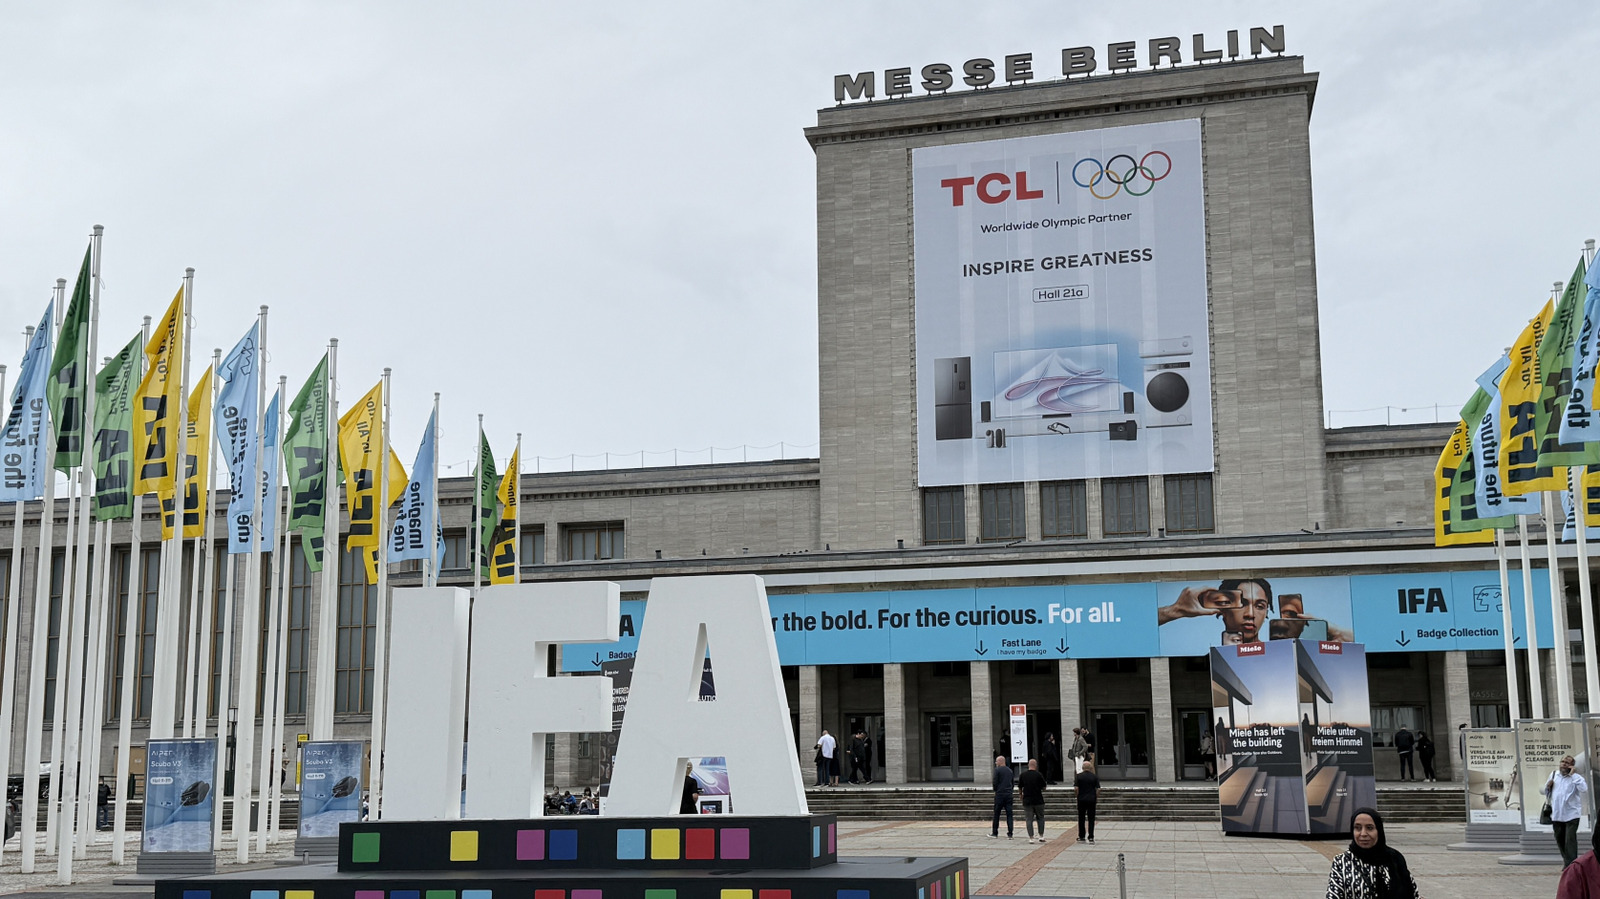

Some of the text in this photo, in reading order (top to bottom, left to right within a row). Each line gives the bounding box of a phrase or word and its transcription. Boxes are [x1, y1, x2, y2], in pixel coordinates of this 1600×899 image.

[834, 25, 1286, 102] MESSE BERLIN
[941, 171, 1044, 207] TCL
[981, 212, 1132, 234] Worldwide Olympic Partner
[963, 248, 1153, 277] INSPIRE GREATNESS
[1038, 287, 1083, 300] Hall 21a
[1397, 587, 1448, 614] IFA
[783, 613, 816, 632] the
[821, 610, 873, 630] bold.
[878, 608, 911, 629] For
[915, 607, 950, 628] the
[955, 605, 1043, 626] curious.
[1048, 602, 1083, 624] For
[1088, 601, 1121, 622] all.
[1416, 627, 1499, 641] Badge Collection
[1001, 638, 1042, 647] Fast Lane
[1240, 645, 1262, 653] Miele
[1321, 643, 1340, 651] Miele
[1027, 648, 1047, 656] badge
[381, 574, 811, 821] IFA
[1229, 726, 1285, 738] Miele has left
[1317, 726, 1357, 736] Miele unter
[1233, 737, 1282, 749] the building
[1312, 736, 1363, 747] freiem Himmel
